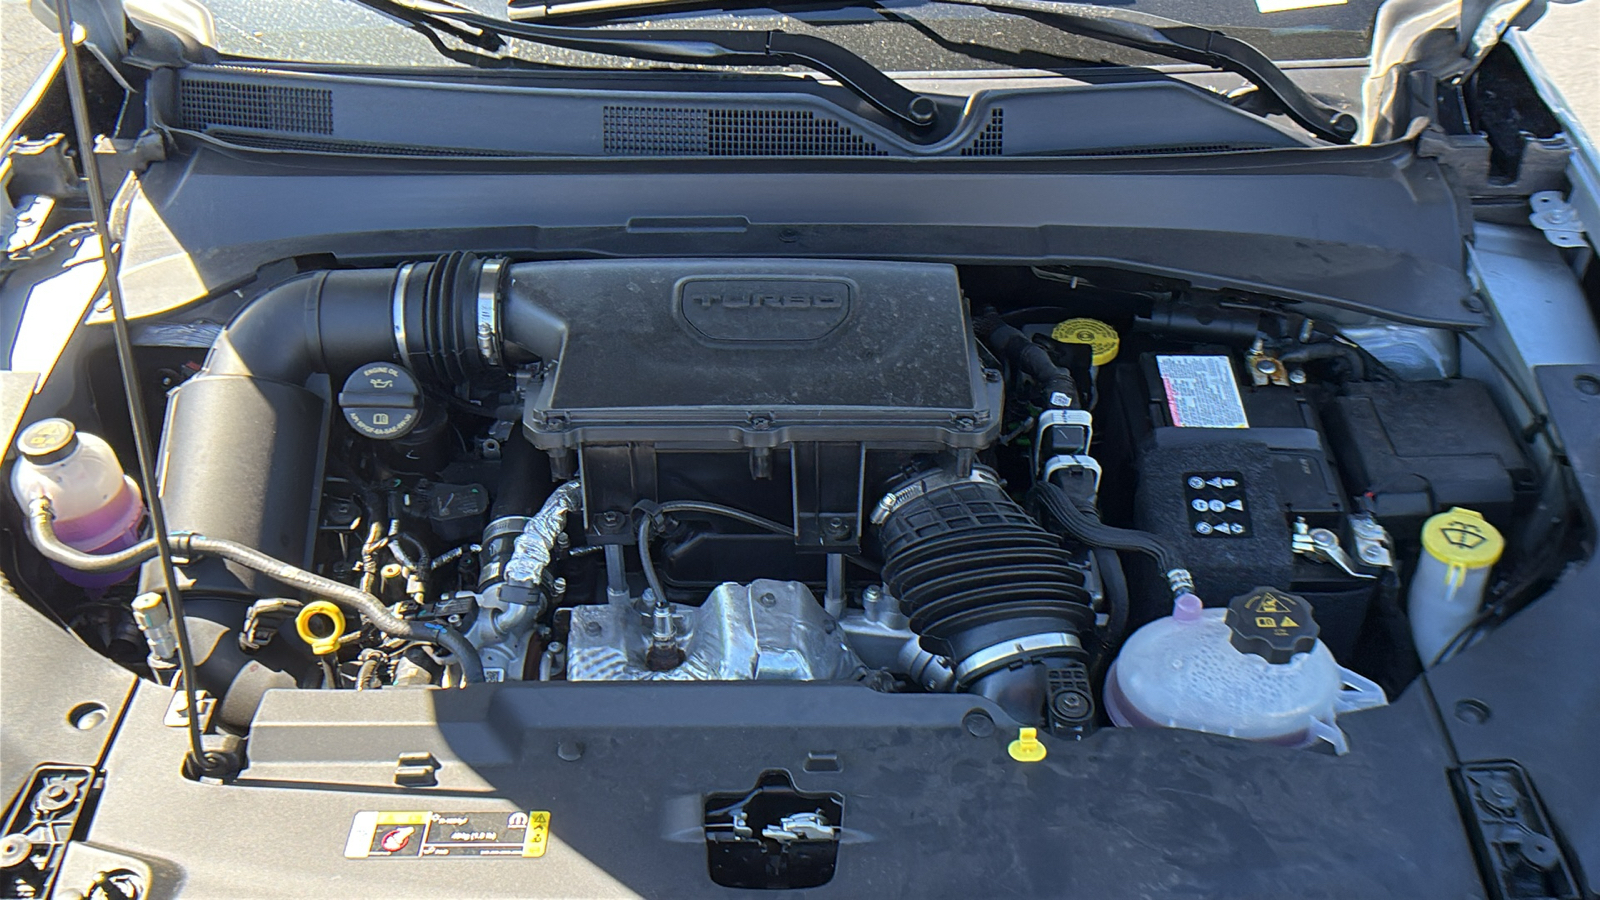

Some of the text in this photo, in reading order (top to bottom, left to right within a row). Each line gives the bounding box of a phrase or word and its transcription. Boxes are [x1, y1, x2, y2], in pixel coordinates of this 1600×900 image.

[691, 294, 842, 308] TURBO
[364, 367, 399, 377] ENGINE OIL
